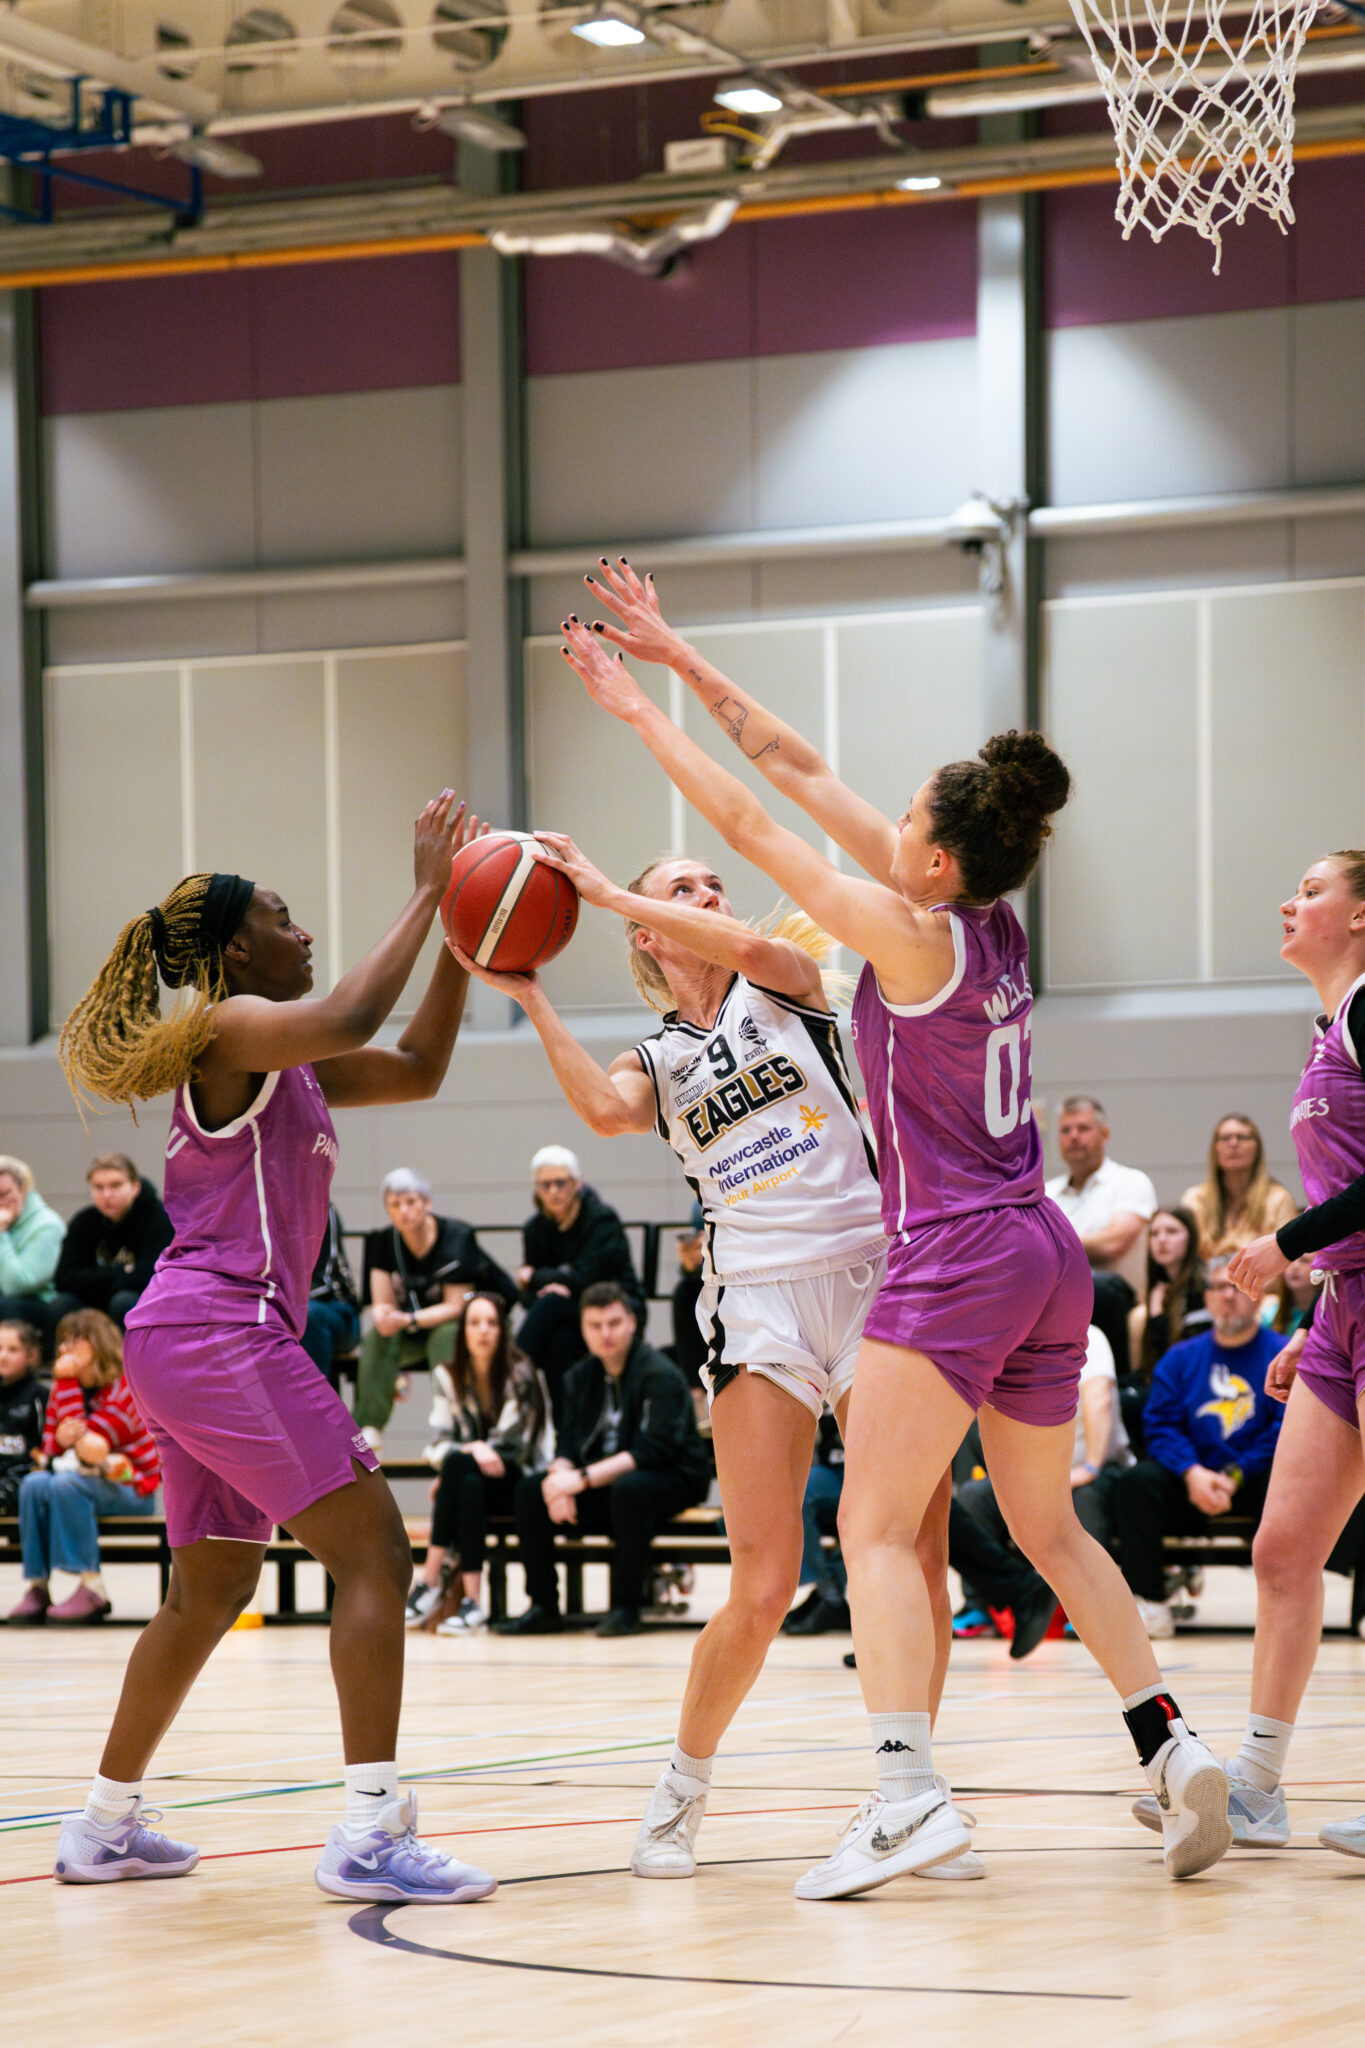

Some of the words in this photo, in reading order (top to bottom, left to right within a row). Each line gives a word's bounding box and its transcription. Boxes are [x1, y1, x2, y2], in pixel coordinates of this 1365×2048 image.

[707, 1034, 737, 1080] 9
[684, 1055, 805, 1149] EAGLES
[709, 1126, 793, 1179] Newcastle
[718, 1132, 820, 1195] International
[724, 1189, 750, 1207] Your
[752, 1165, 799, 1195] Airport
